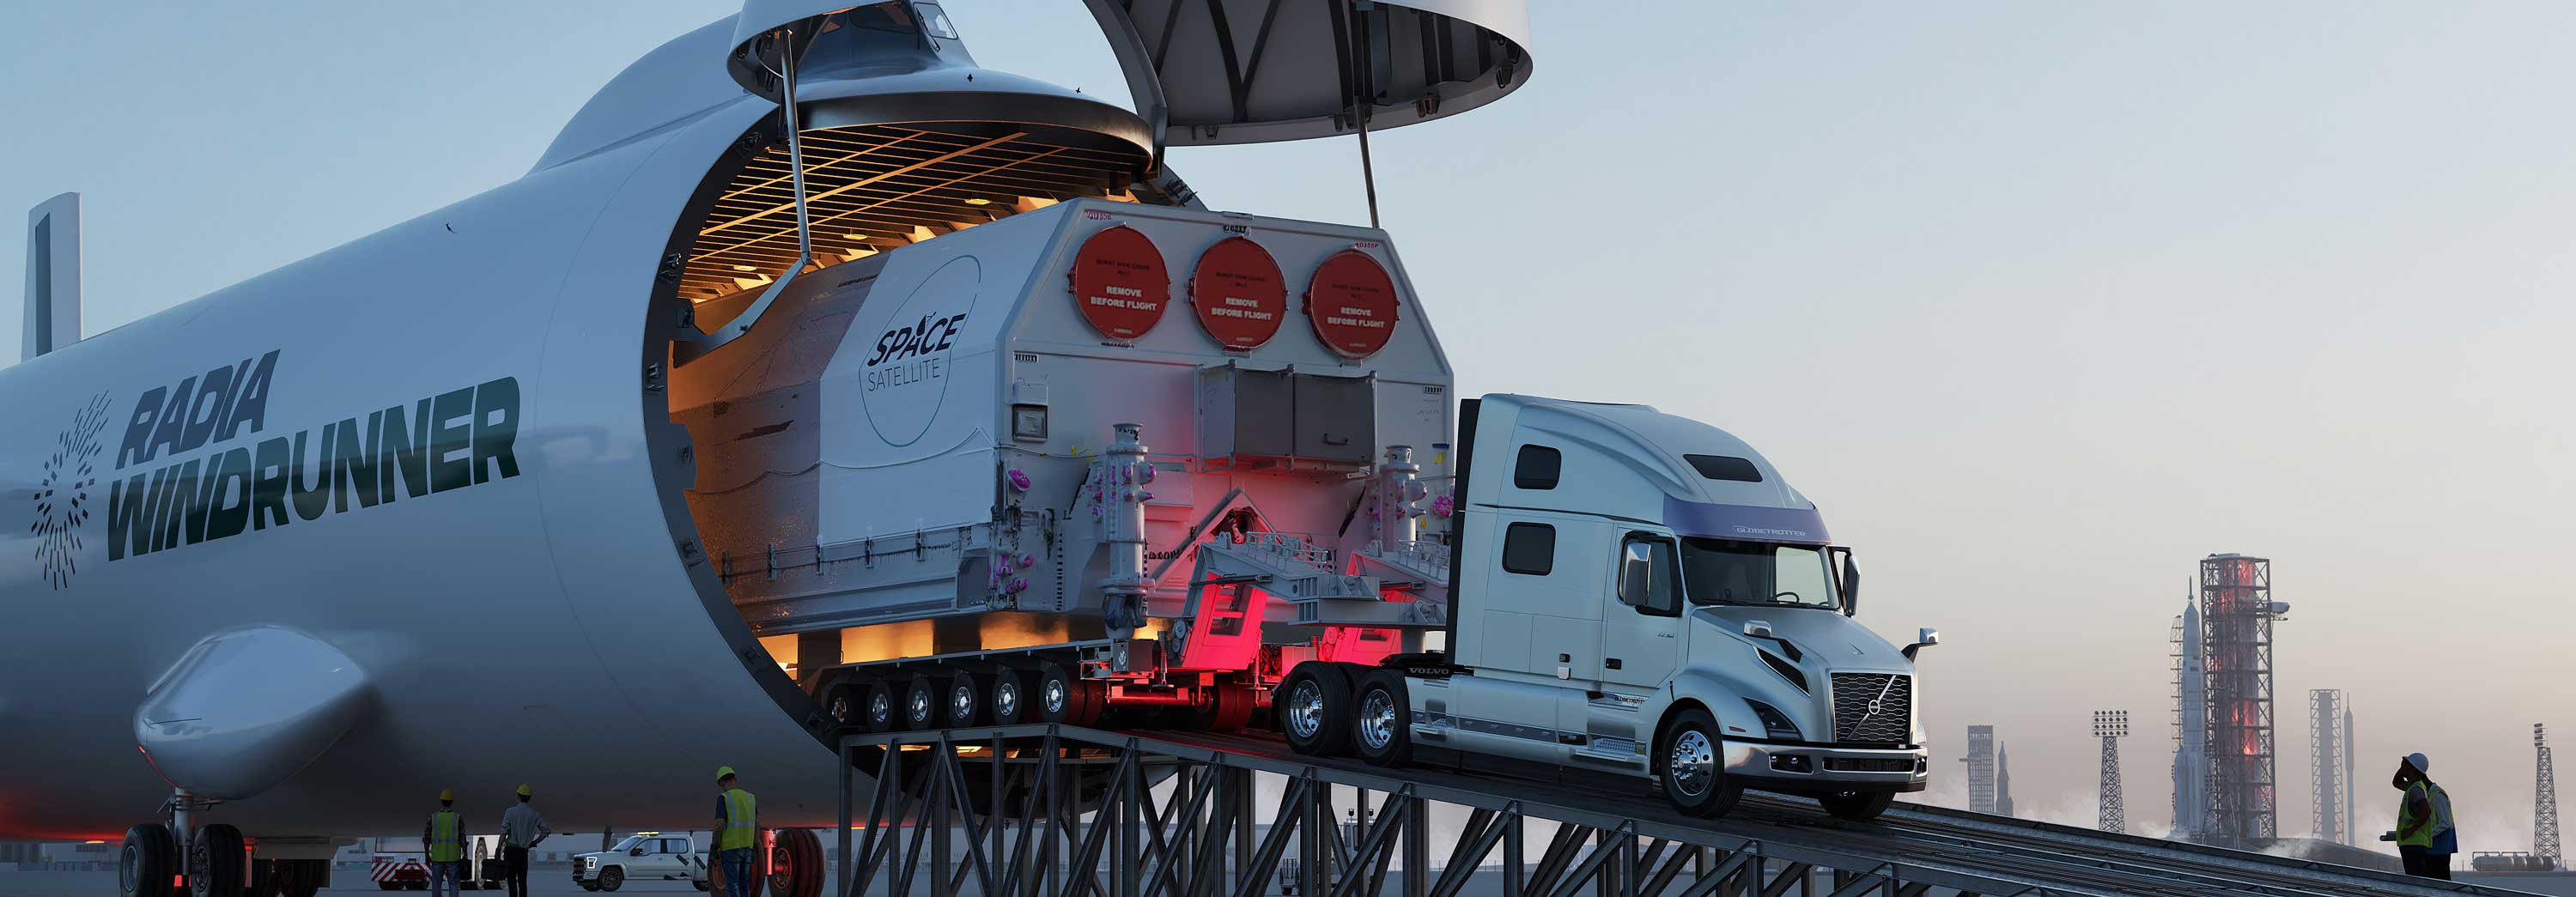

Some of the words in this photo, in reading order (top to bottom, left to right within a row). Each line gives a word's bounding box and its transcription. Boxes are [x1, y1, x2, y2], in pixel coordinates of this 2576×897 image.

[1106, 286, 1141, 297] REMOVE
[1091, 296, 1125, 308] BEFORE
[1127, 300, 1157, 311] FLIGHT
[1225, 297, 1258, 307] REMOVE
[1211, 307, 1242, 318] BEFORE
[1244, 311, 1272, 320] FLIGHT
[1340, 307, 1371, 317] REMOVE
[1327, 317, 1357, 325] BEFORE
[1358, 319, 1384, 328] FLIGHT
[867, 312, 967, 367] SPACE
[868, 357, 940, 391] SATELLITE
[115, 348, 281, 470] RADIA
[108, 376, 520, 562] WINDRUNNER
[1736, 527, 1807, 536] GLOBETROTTER
